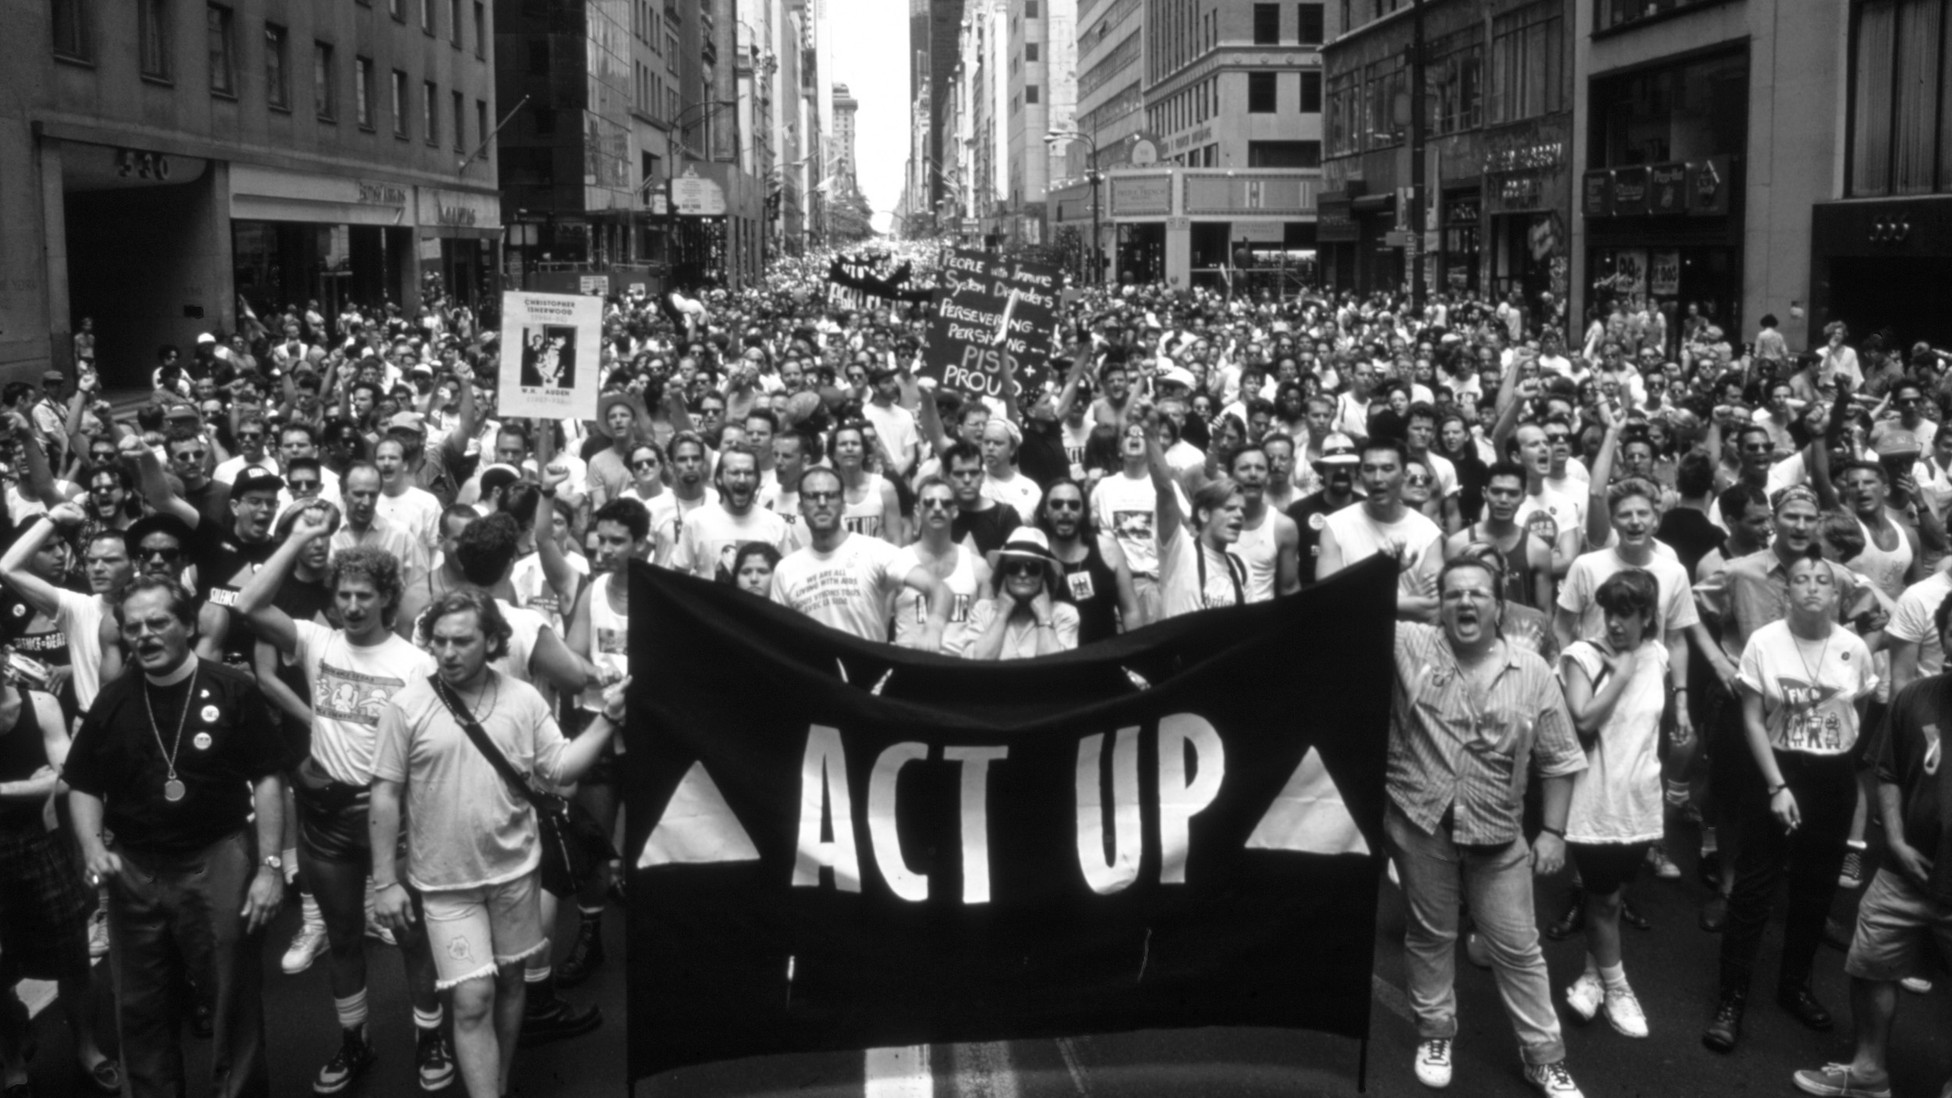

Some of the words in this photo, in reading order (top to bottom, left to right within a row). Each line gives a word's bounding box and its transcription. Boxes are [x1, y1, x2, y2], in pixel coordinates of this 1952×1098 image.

[942, 249, 985, 274] PEOPLE
[945, 269, 986, 298] System
[524, 298, 575, 309] CHRISTOPHER
[527, 306, 573, 316] ISHERWOOD
[819, 570, 832, 579] ARE
[833, 568, 846, 577] ALL
[796, 582, 818, 598] LIVING
[820, 577, 839, 586] WITH
[791, 723, 1009, 904] ACT
[1075, 712, 1225, 894] UP
